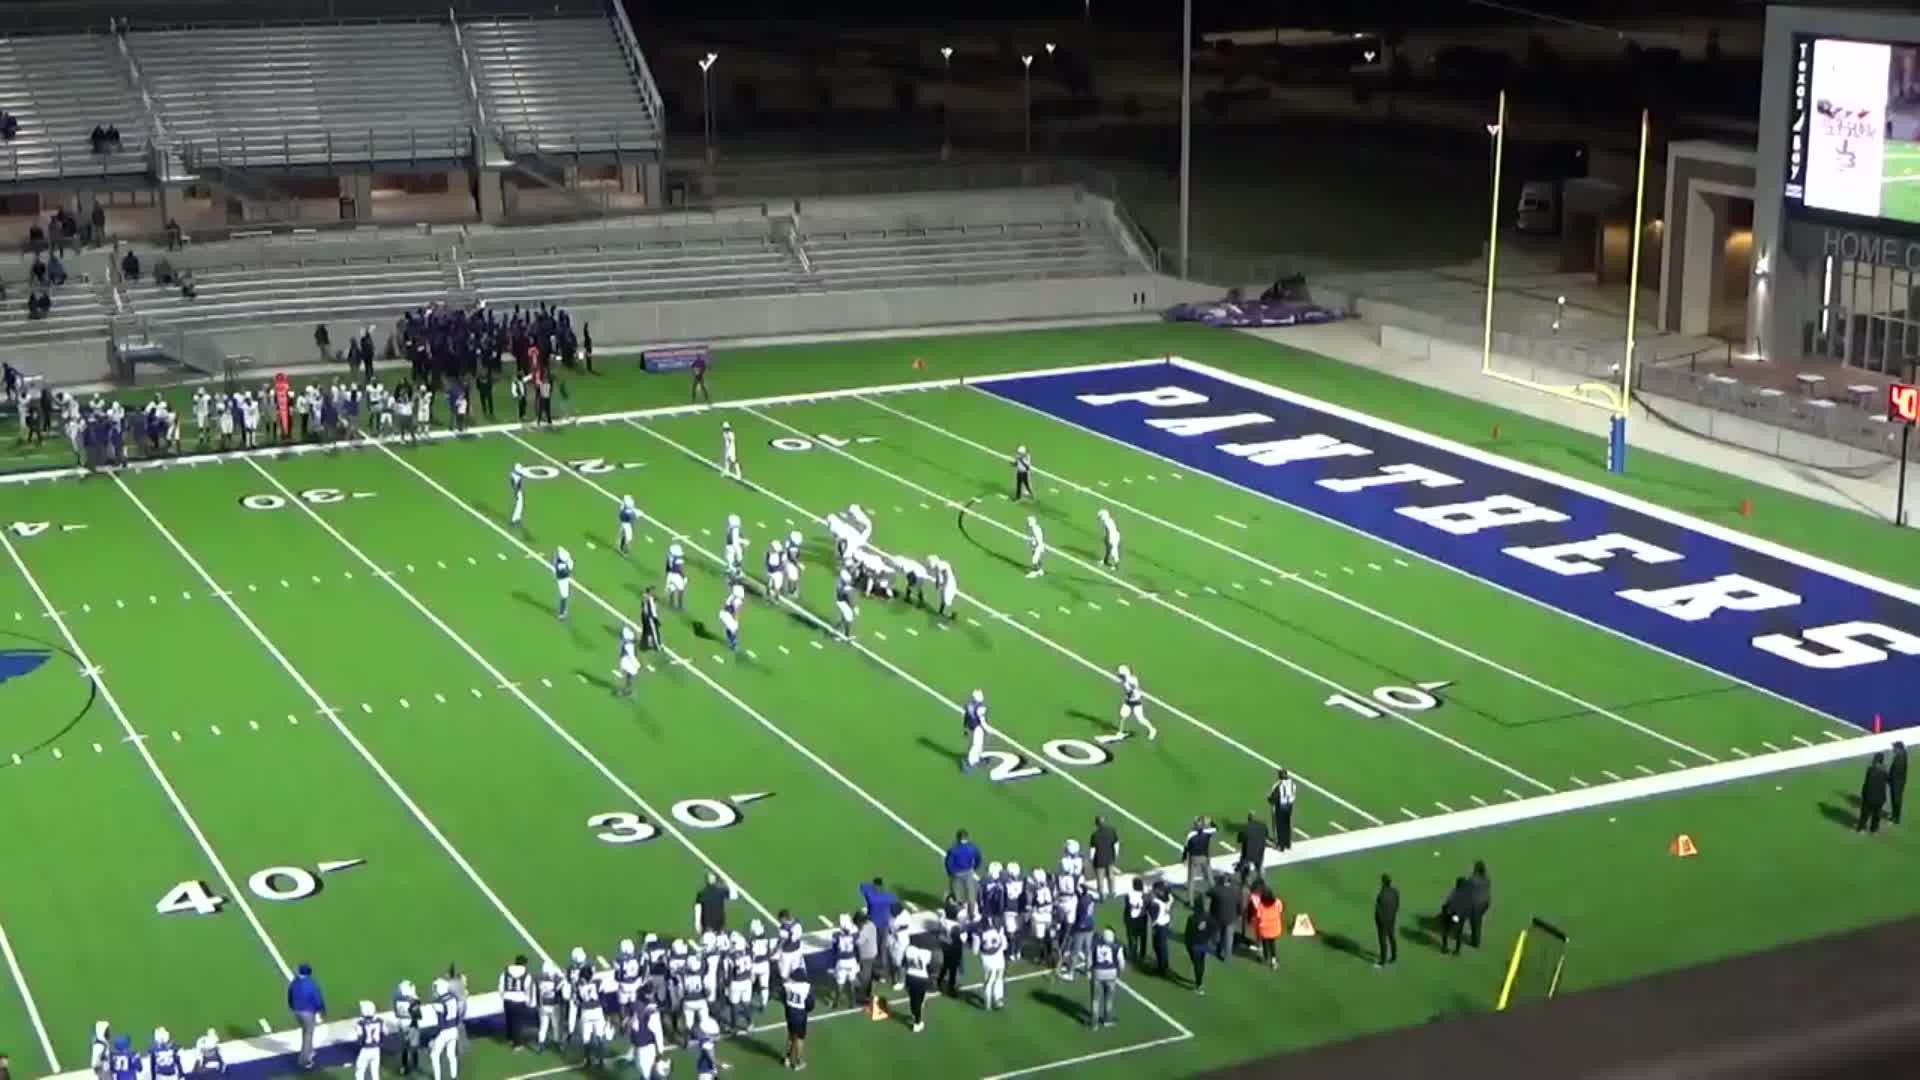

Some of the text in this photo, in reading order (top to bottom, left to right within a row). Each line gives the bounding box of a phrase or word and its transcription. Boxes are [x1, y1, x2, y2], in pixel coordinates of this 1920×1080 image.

[1824, 230, 1897, 264] HOME
[1892, 386, 1917, 420] 40
[1077, 386, 1920, 669] PANTHERS
[1325, 685, 1438, 718] 10
[587, 798, 737, 843] 30
[156, 866, 317, 914] 40
